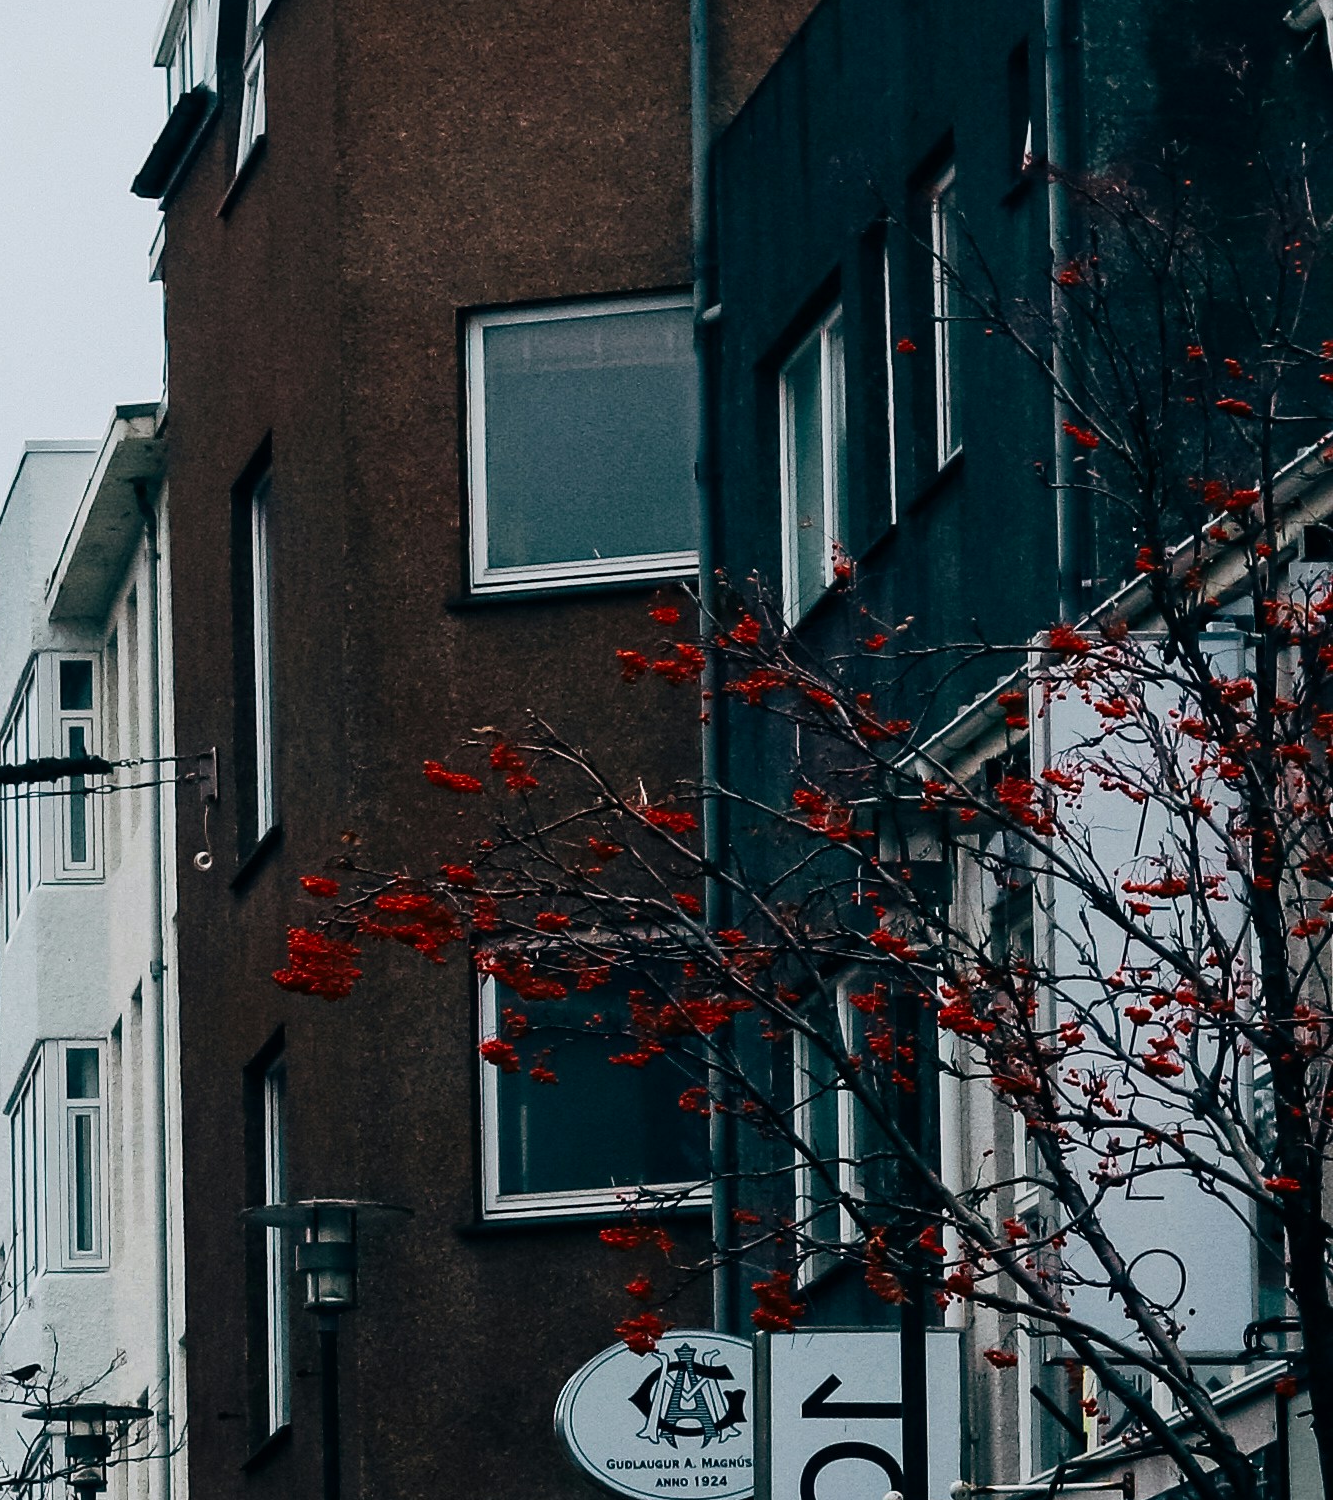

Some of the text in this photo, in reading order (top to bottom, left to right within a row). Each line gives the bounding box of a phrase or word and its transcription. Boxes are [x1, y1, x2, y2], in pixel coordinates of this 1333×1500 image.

[684, 1457, 696, 1468] A.
[655, 1476, 727, 1487] ANNO 1924
